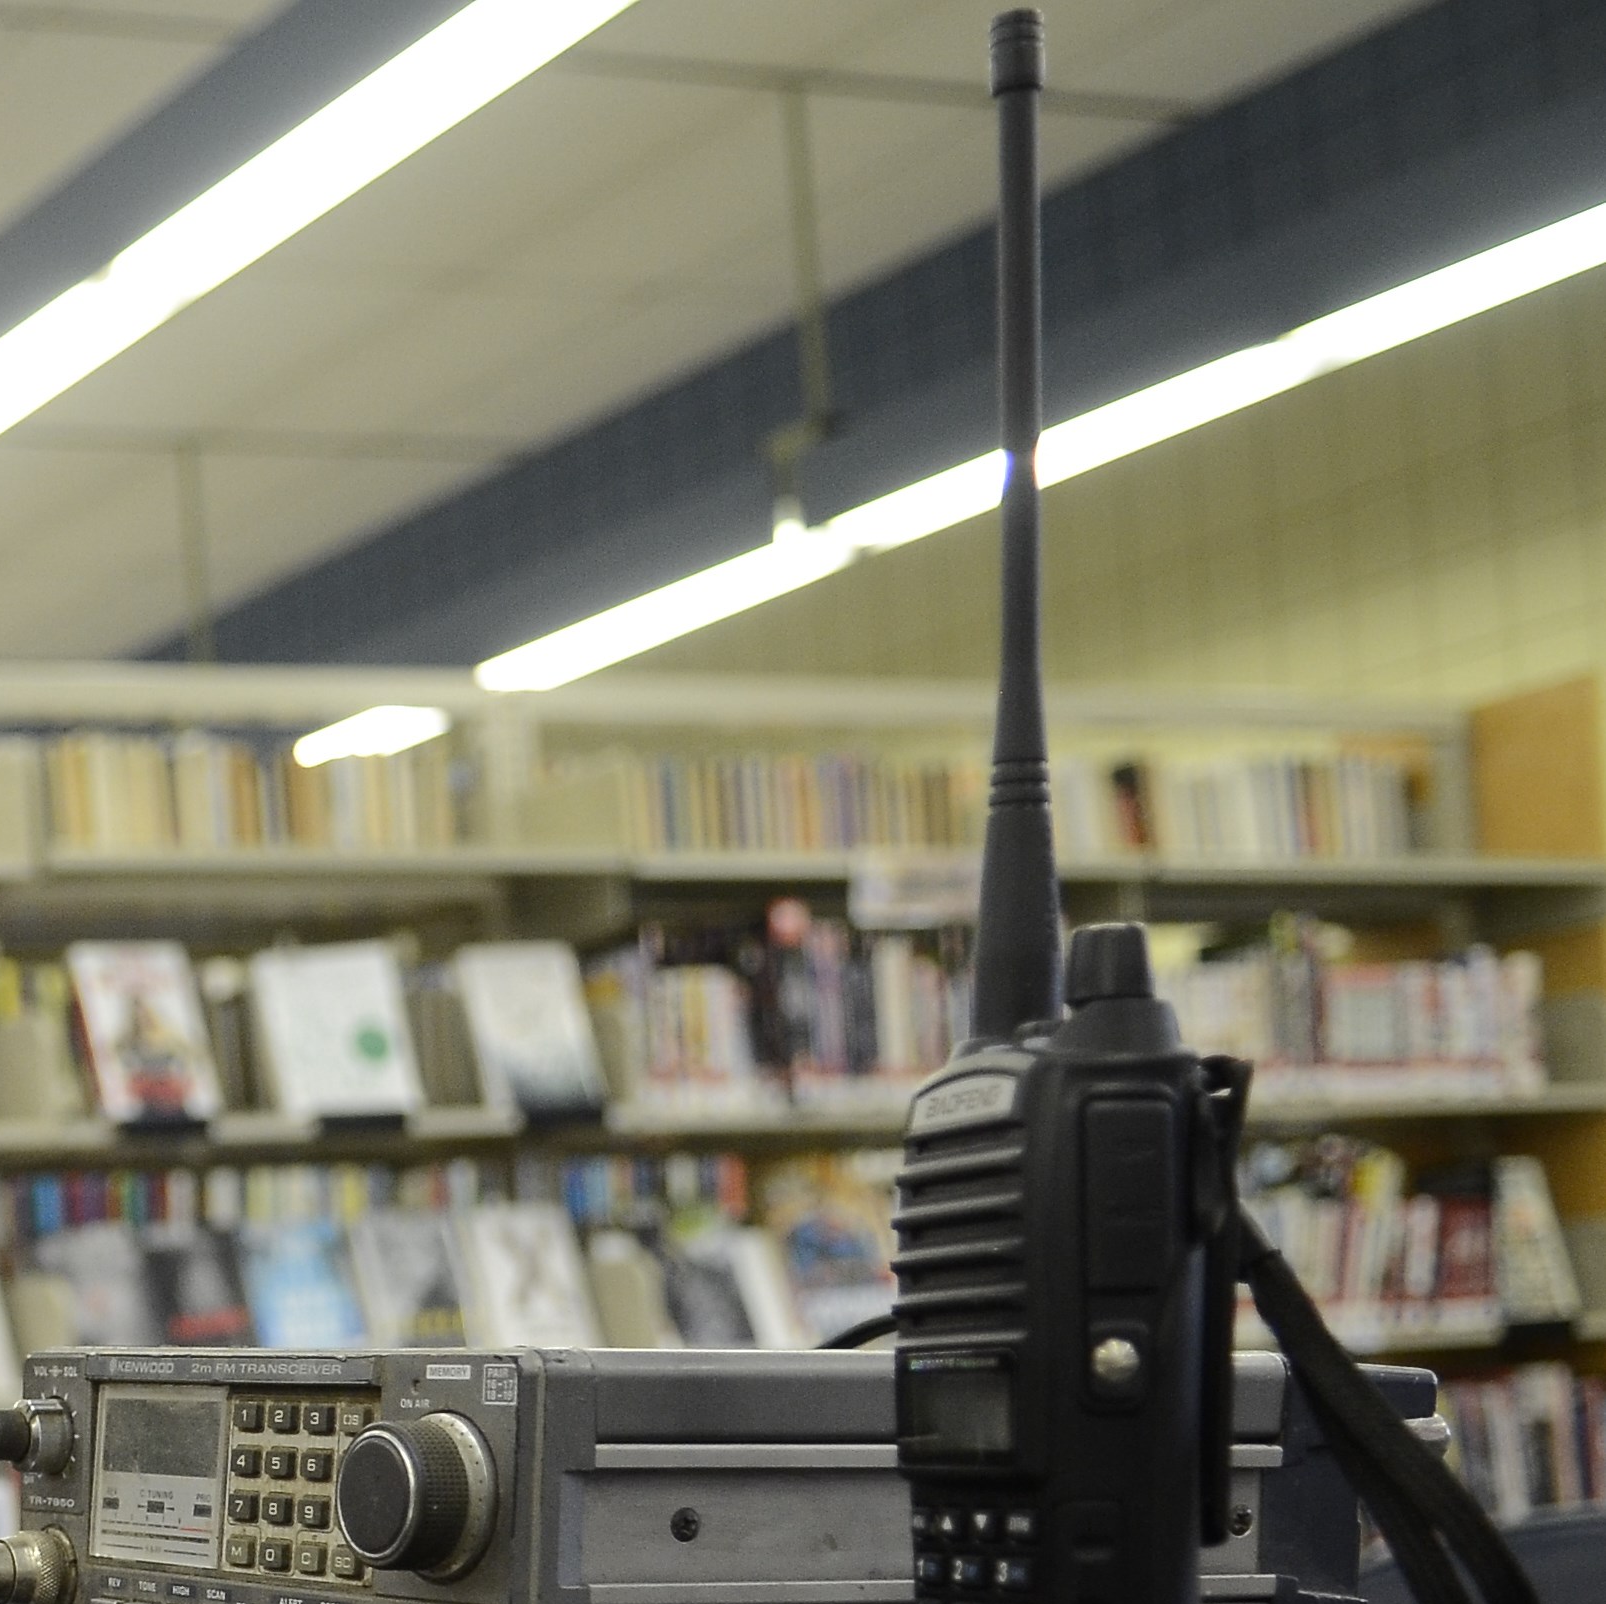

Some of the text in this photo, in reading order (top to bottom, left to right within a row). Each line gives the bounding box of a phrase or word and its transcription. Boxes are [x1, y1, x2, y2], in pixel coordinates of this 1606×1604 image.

[33, 1365, 78, 1377] VOL SQL
[117, 1360, 342, 1375] KENWOOD 2m FM TRANSCEIVER
[429, 1366, 468, 1377] MEMORY
[488, 1368, 509, 1378] PAIR
[400, 1398, 430, 1408] ON AIR
[241, 1410, 247, 1421] 1
[274, 1410, 284, 1423] 2
[309, 1412, 320, 1425] 3
[237, 1455, 246, 1467] 4
[271, 1457, 281, 1470] 5
[307, 1458, 316, 1472] 6
[235, 1500, 244, 1512] 7
[268, 1503, 278, 1515] 8
[304, 1506, 314, 1519] 9
[231, 1546, 242, 1557] M
[265, 1549, 275, 1561] 0
[301, 1552, 311, 1564] C
[335, 1557, 351, 1569] SC
[916, 1559, 924, 1576] 1
[954, 1560, 963, 1580] 2
[998, 1562, 1008, 1582] 3
[108, 1577, 121, 1588] REV
[139, 1581, 156, 1592] TONE
[172, 1585, 190, 1597] HIGH
[206, 1589, 226, 1600] SCAN
